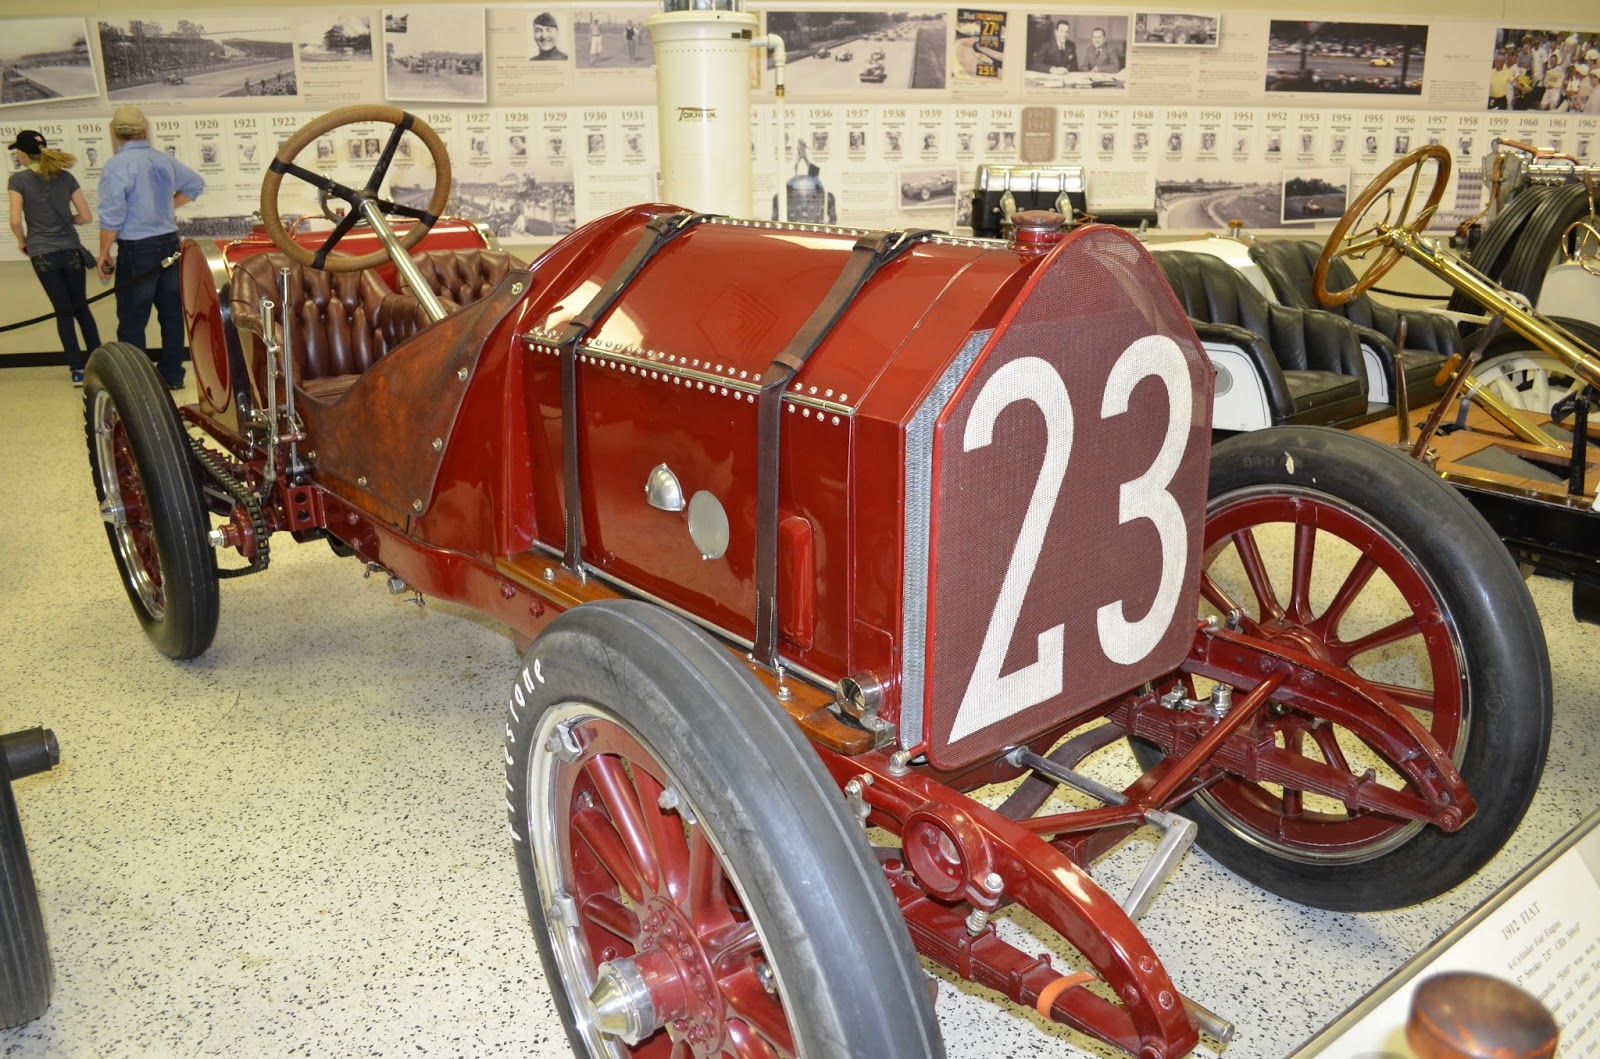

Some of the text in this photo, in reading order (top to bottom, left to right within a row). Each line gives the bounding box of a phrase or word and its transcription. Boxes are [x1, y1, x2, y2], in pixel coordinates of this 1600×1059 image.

[427, 114, 452, 123] 1926
[466, 113, 490, 123] 1927
[505, 112, 529, 122] 1928
[543, 112, 567, 122] 1929
[583, 111, 607, 121] 1930
[621, 111, 645, 120] 1931
[677, 106, 719, 121] TOKHIM
[772, 109, 795, 119] 135
[809, 109, 833, 119] 1936
[846, 109, 869, 119] 1937
[882, 109, 906, 119] 1938
[919, 109, 942, 119] 1939
[955, 109, 978, 119] 1940
[991, 109, 1013, 119] 1941
[1062, 109, 1085, 119] 1946
[1098, 110, 1120, 120] 1947
[1132, 110, 1154, 120] 1948
[1166, 111, 1188, 120] 1949
[1200, 111, 1222, 121] 1950
[1233, 111, 1254, 121] 1951
[1266, 111, 1288, 121] 1952
[1299, 113, 1320, 122] 1953
[1331, 113, 1352, 122] 1954
[1363, 114, 1384, 123] 1955
[194, 119, 219, 130] 1920
[233, 118, 257, 128] 1921
[272, 117, 297, 127] 1922
[1395, 115, 1416, 124] 1956
[1427, 115, 1448, 125] 1957
[1458, 116, 1479, 126] 1958
[1489, 117, 1509, 126] 1959
[1519, 118, 1539, 128] 1960
[1548, 118, 1567, 128] 1961
[1577, 119, 1597, 128] 1962
[38, 125, 63, 135] 1915
[77, 123, 102, 133] 1916
[155, 120, 180, 131] 1919
[948, 334, 1192, 744] 23
[1501, 901, 1540, 940] 1912 FIAT
[1544, 920, 1561, 938] Engine
